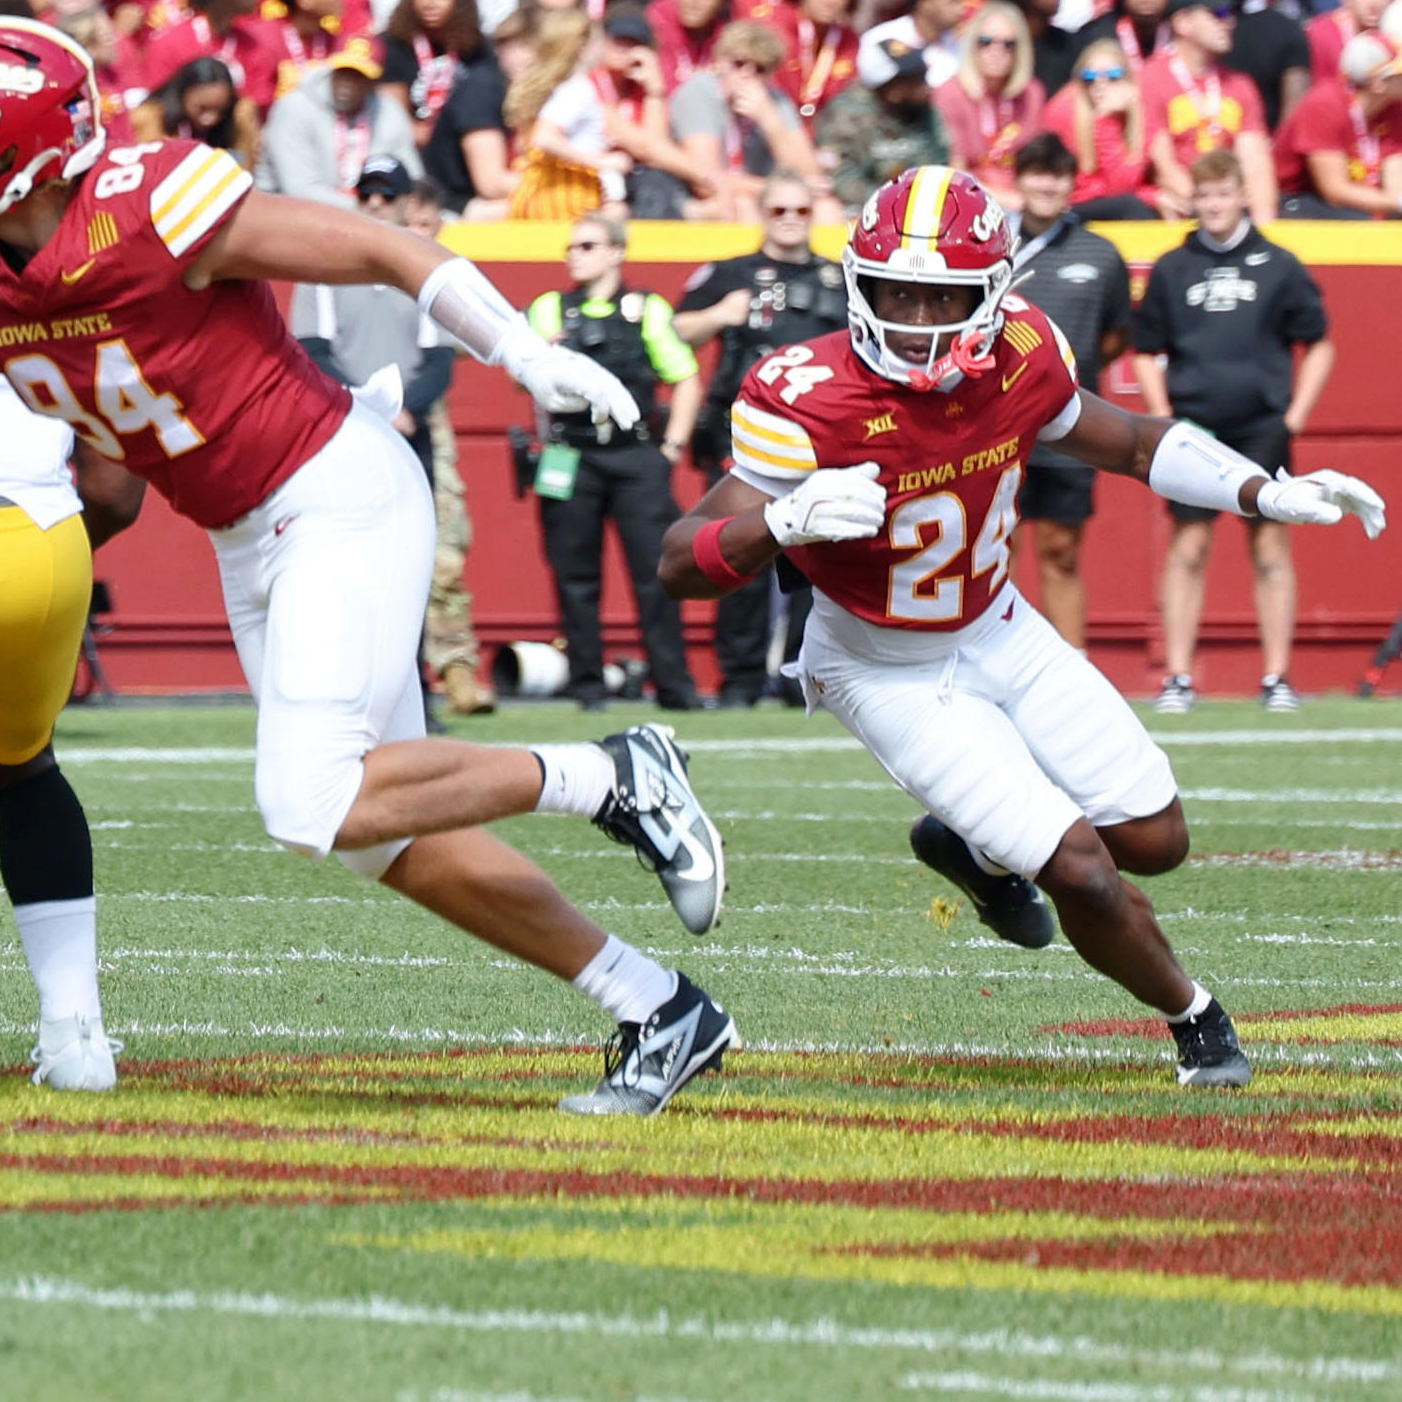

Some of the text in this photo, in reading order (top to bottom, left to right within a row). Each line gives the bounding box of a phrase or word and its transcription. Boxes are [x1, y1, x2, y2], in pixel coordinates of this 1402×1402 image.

[94, 141, 163, 200] 84
[52, 311, 113, 342] STATE
[756, 344, 835, 406] 24
[897, 436, 1020, 494] IOWA STATE
[885, 460, 1023, 624] 24
